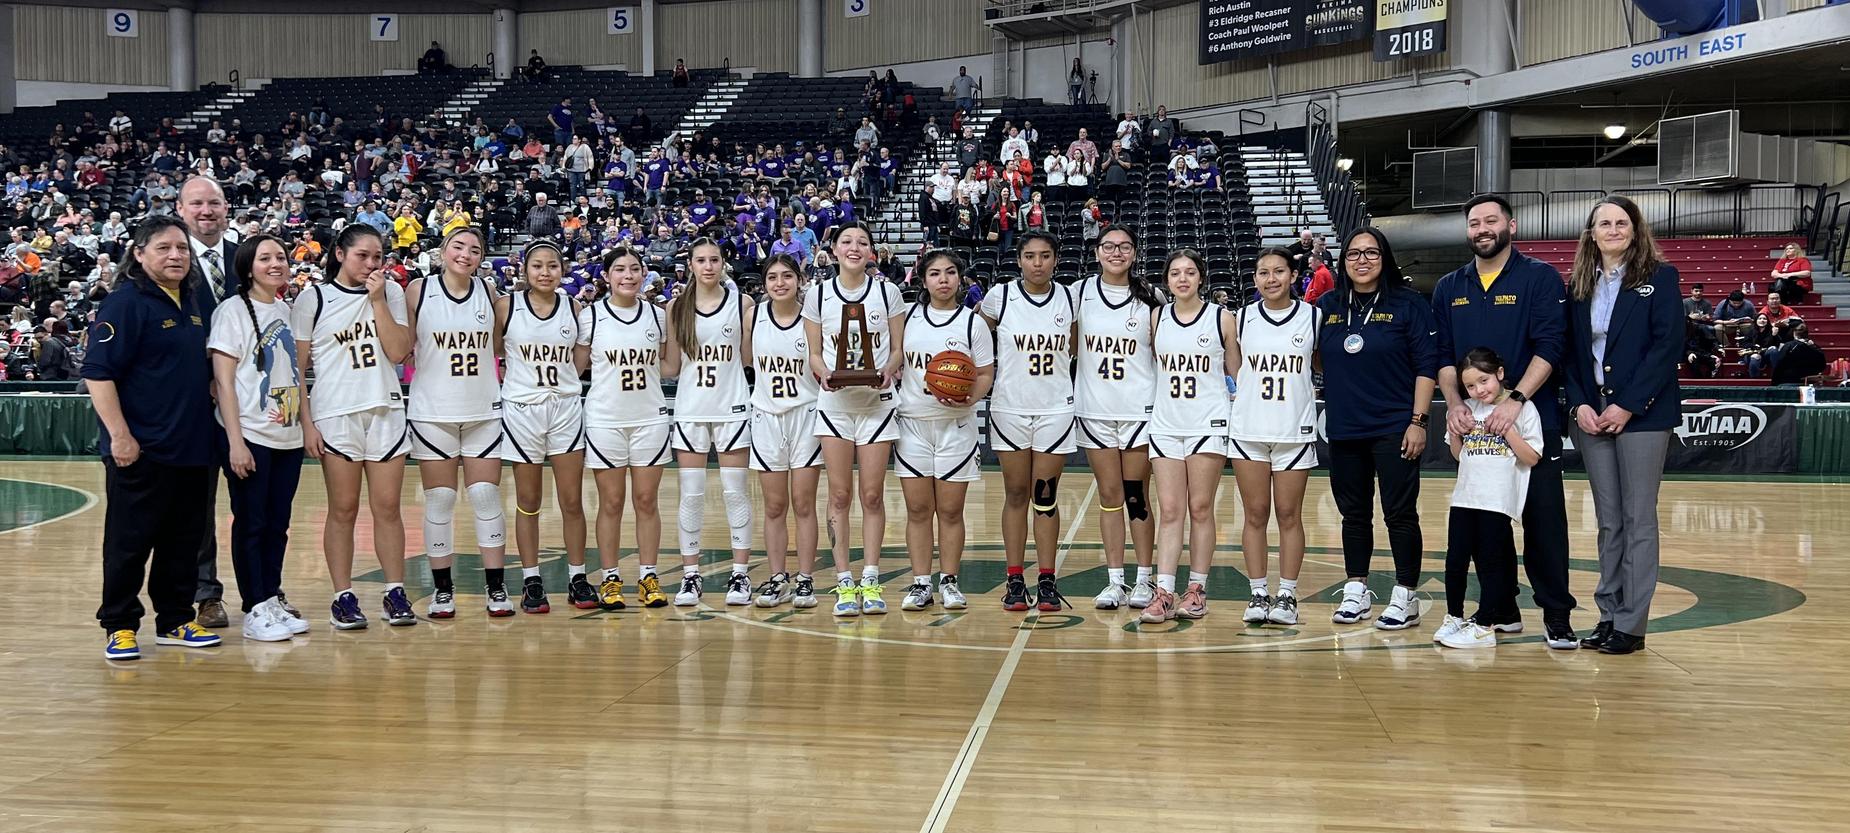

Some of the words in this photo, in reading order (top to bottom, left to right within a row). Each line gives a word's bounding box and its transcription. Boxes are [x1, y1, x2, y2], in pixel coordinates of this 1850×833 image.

[1208, 19, 1219, 28] #3
[1220, 13, 1254, 26] Eldridge
[1254, 7, 1291, 20] Recasner
[1209, 5, 1225, 15] Rich
[1226, 1, 1251, 12] Austin
[1381, 0, 1444, 16] CHAMPIONS
[114, 12, 131, 32] 9
[377, 17, 391, 37] 7
[614, 9, 628, 30] 5
[1208, 29, 1232, 41] Coach
[1233, 26, 1250, 37] Paul
[1251, 19, 1289, 33] Woolpert
[1313, 24, 1353, 35] BASKETBALL
[1208, 44, 1219, 54] #6
[1220, 39, 1253, 52] Anthony
[1254, 32, 1292, 46] Goldwire
[1389, 28, 1434, 56] 2018
[1631, 44, 1688, 69] SOUTH
[1700, 33, 1747, 57] EAST
[433, 331, 489, 349] WAPATO
[1013, 334, 1066, 352] WAPATO
[1084, 334, 1137, 356] WAPATO
[348, 343, 377, 370] 12
[451, 353, 479, 377] 22
[605, 348, 657, 367] WAPATO
[758, 355, 804, 376] WAPATO
[905, 351, 932, 370] WAP
[1028, 353, 1054, 376] 32
[1158, 353, 1210, 373] WAPATO
[1247, 354, 1304, 374] WAPATO
[535, 365, 559, 387] 10
[696, 365, 717, 388] 15
[1097, 357, 1125, 380] 45
[621, 368, 647, 391] 23
[772, 375, 798, 398] 20
[1170, 375, 1196, 399] 33
[1261, 376, 1285, 401] 31
[1687, 416, 1752, 434] WIAA
